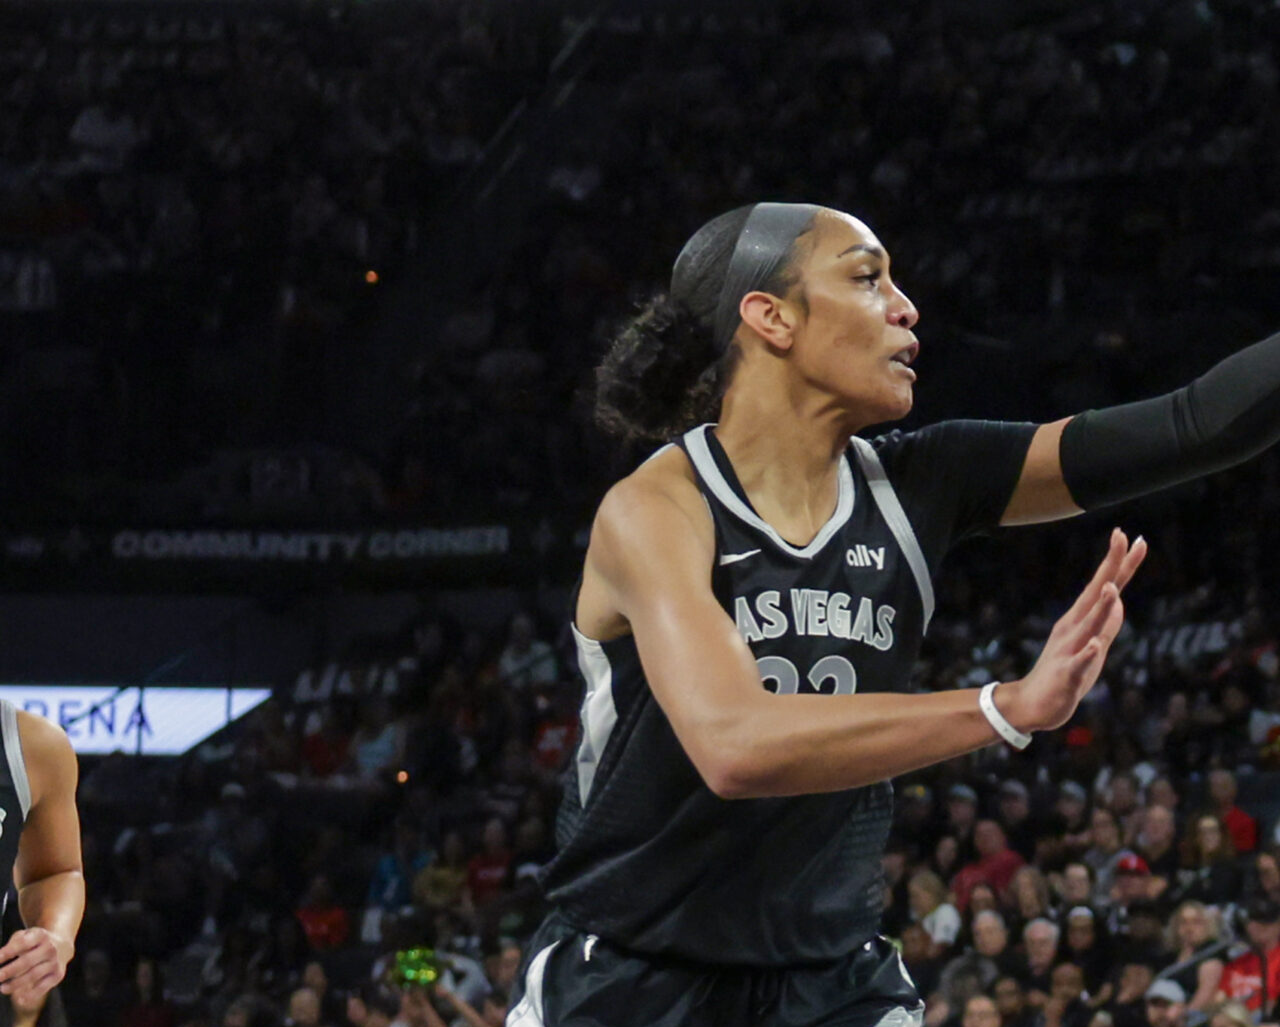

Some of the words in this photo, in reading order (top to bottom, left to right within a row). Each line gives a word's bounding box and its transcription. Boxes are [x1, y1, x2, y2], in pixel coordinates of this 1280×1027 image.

[846, 544, 885, 570] ally
[735, 590, 789, 643] AS
[790, 588, 896, 651] VEGAS
[24, 700, 153, 738] ENA
